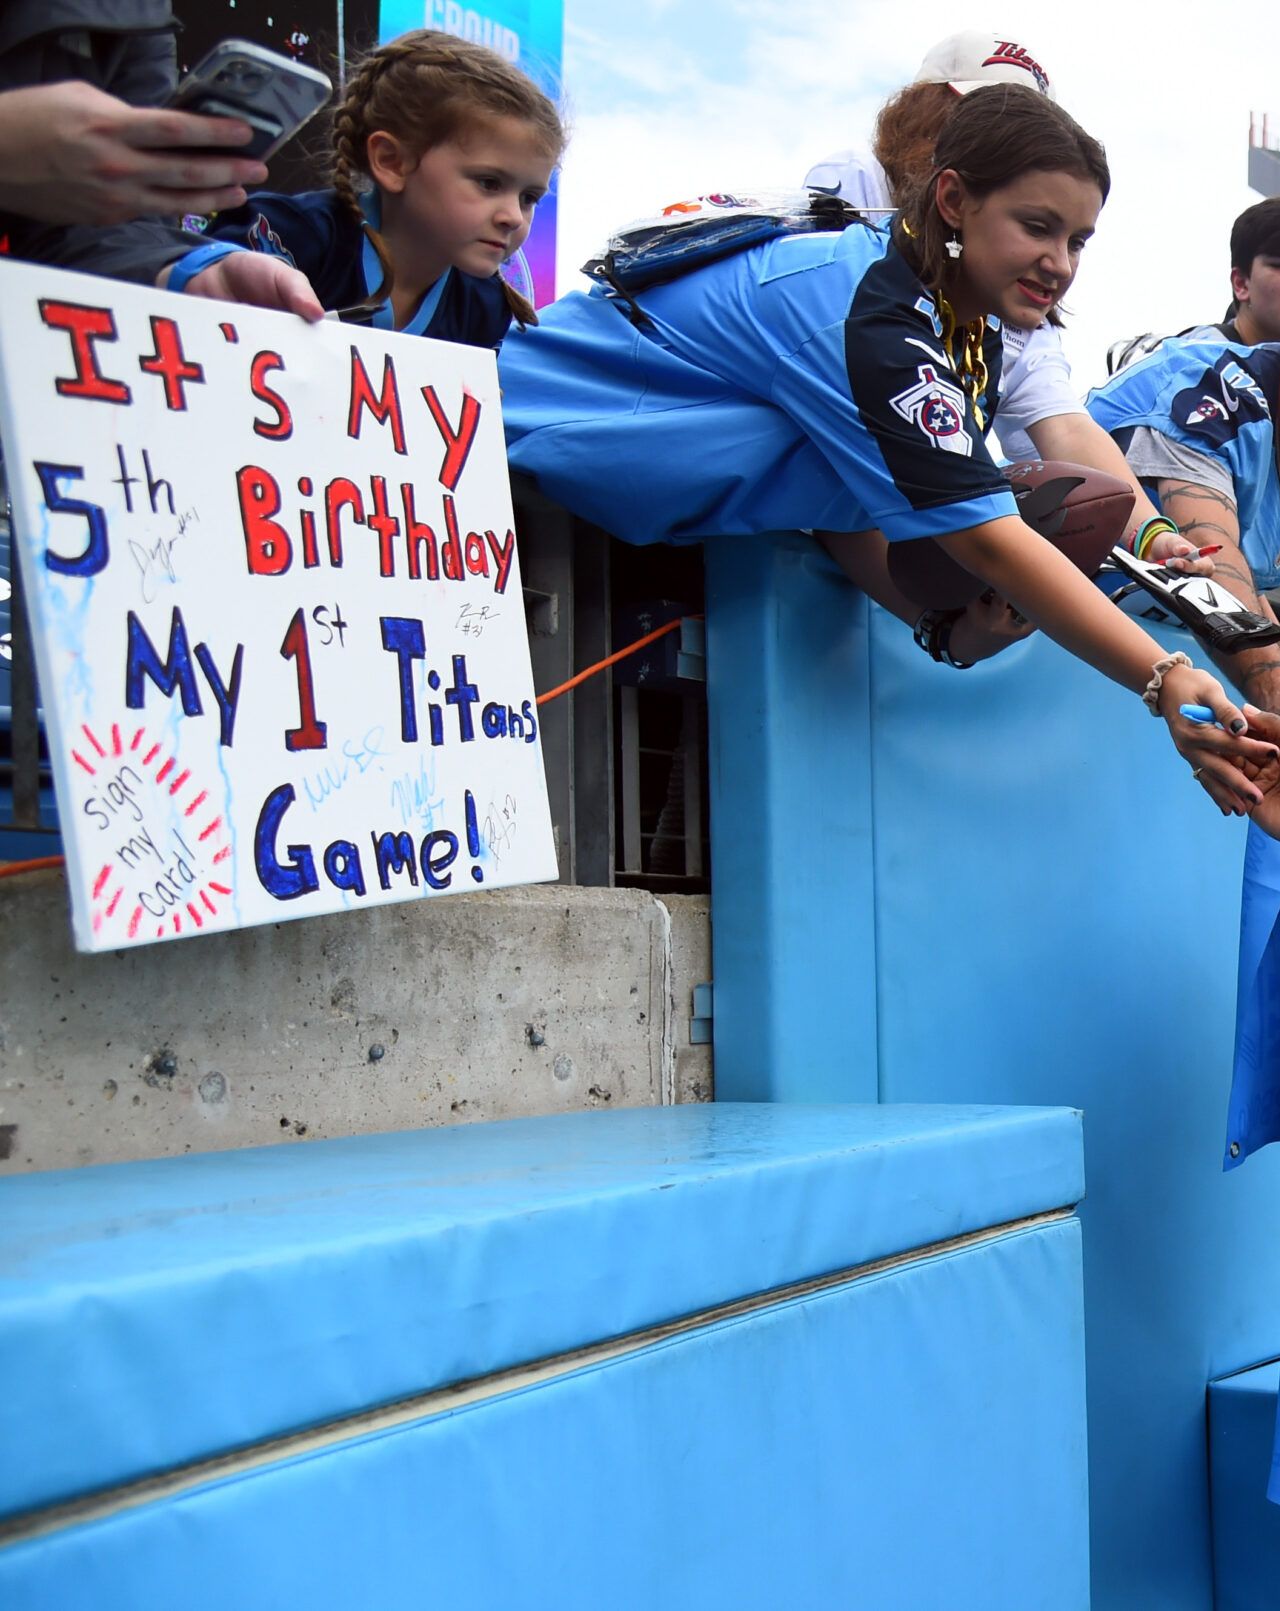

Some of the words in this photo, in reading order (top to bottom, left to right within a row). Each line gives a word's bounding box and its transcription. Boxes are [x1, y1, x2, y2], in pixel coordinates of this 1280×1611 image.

[39, 298, 294, 441] It's
[33, 444, 176, 579] 5th
[235, 465, 515, 594] Birthday
[280, 604, 348, 752] 1st
[380, 616, 539, 745] Titans
[116, 826, 165, 869] my
[254, 783, 485, 900] Game!
